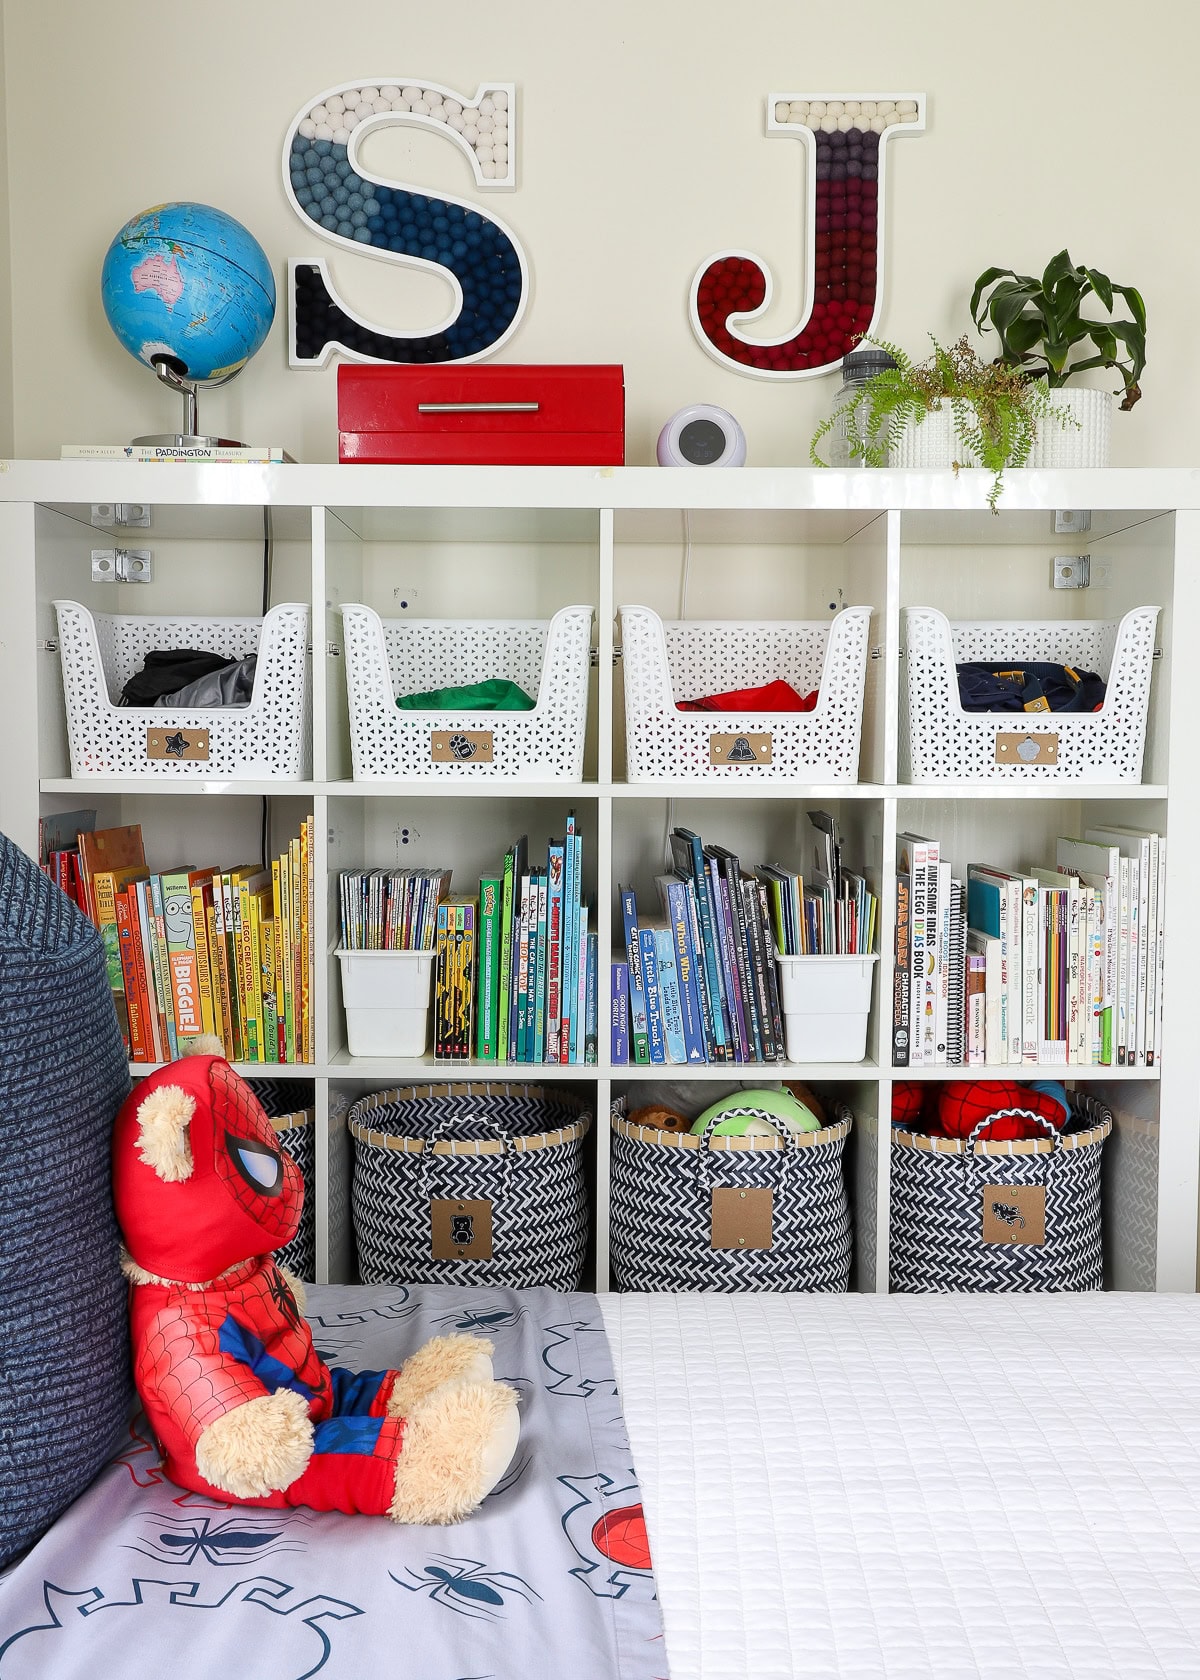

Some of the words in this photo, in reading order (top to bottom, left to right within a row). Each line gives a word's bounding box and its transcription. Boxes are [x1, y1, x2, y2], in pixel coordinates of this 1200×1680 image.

[282, 77, 533, 369] S
[915, 867, 925, 886] THE
[928, 865, 937, 914] AWESOME
[898, 882, 909, 925] STAR
[915, 890, 925, 915] LEGO
[194, 911, 203, 930] WHAT
[196, 931, 204, 940] DO
[914, 919, 924, 948] IDEAS
[927, 917, 937, 946] IDEAS
[1026, 911, 1035, 937] Jack
[134, 930, 143, 970] GOODNIGHT
[676, 921, 687, 954] Who's
[897, 926, 908, 968] WARS
[197, 944, 210, 983] DINOSAURS
[244, 946, 253, 991] CREATIONS
[550, 943, 559, 980] MARVEL
[644, 952, 655, 983] Little
[680, 956, 690, 982] Who
[913, 951, 924, 979] BOOK
[174, 965, 200, 1032] BIGGIE!
[201, 985, 210, 998] DO?
[647, 986, 657, 1010] Blue
[1026, 969, 1035, 1025] Beanstalk
[130, 1004, 140, 1041] Halloween
[649, 1012, 661, 1046] Truck
[548, 1032, 558, 1055] MARVEL
